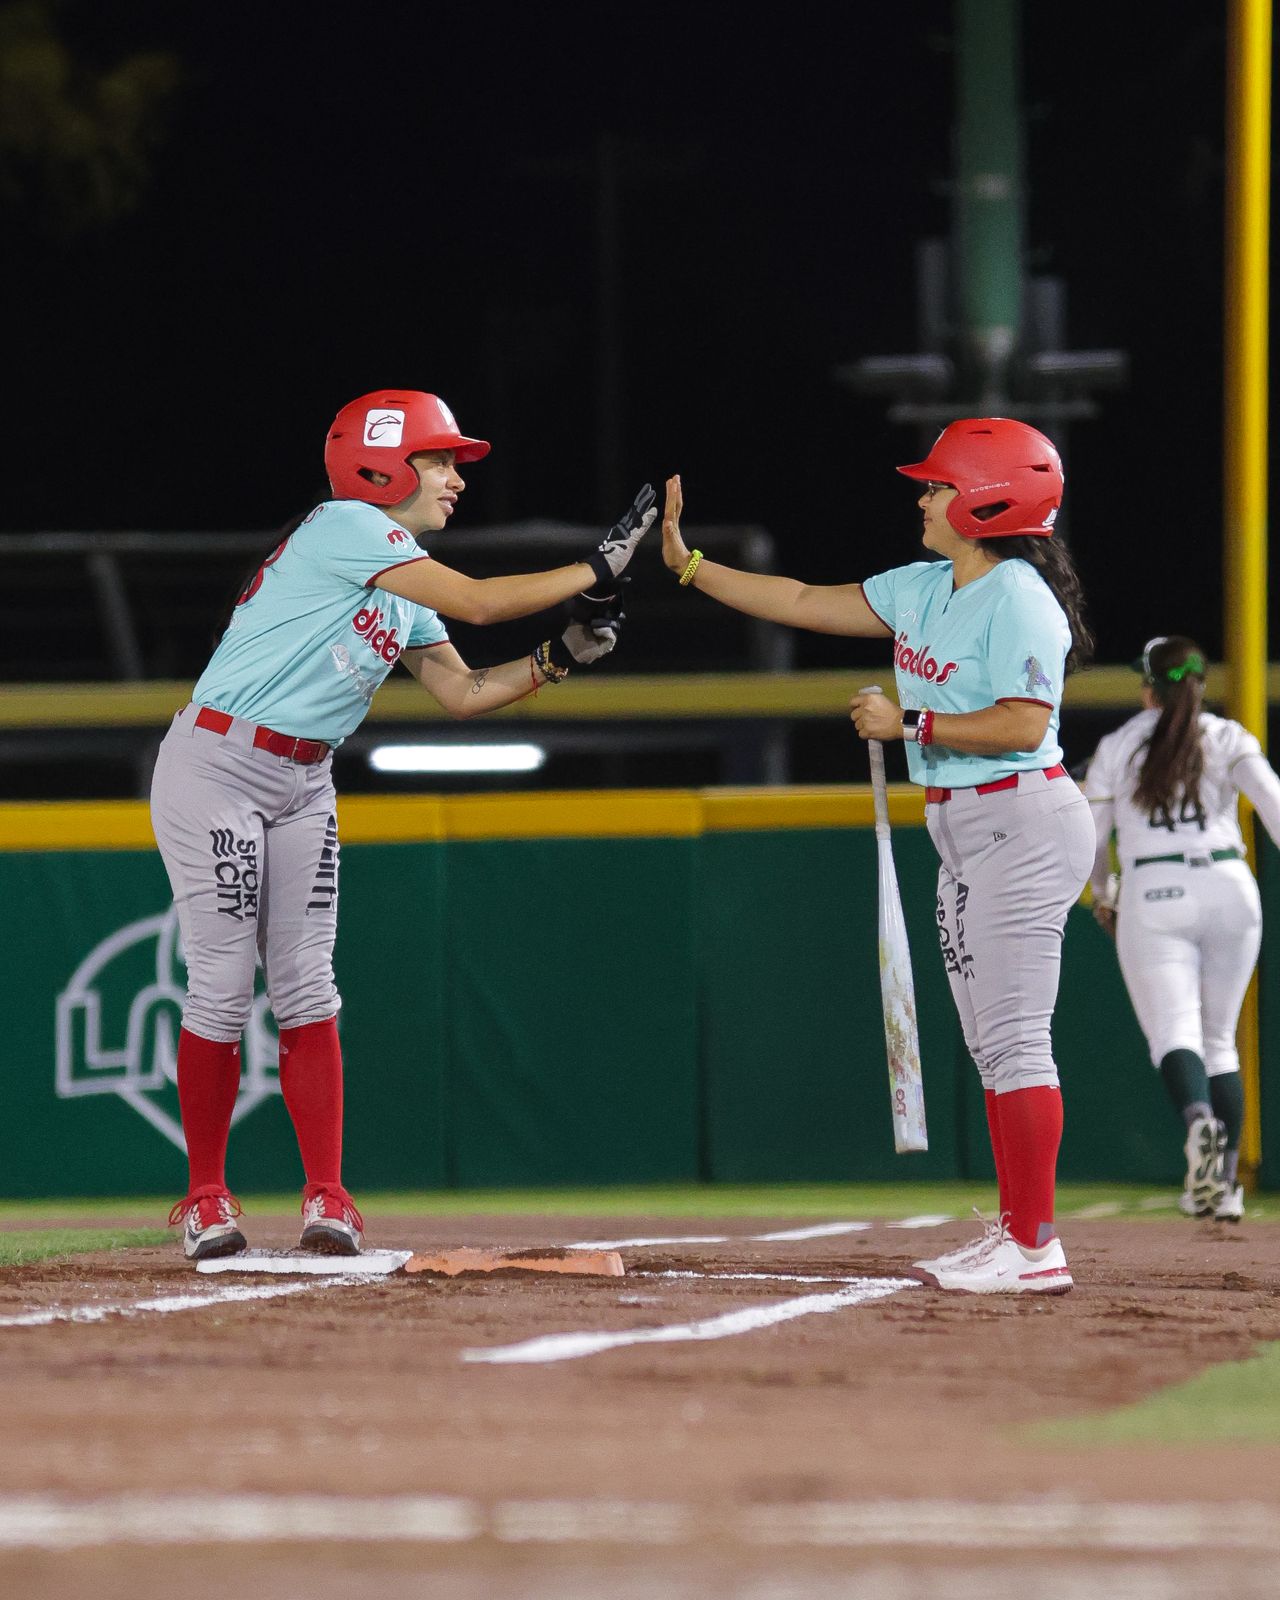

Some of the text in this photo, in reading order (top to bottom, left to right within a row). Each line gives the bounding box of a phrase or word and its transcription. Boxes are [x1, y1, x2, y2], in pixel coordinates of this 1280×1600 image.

[352, 605, 402, 667] diab
[214, 861, 244, 922] CITY
[237, 839, 258, 922] SPORT
